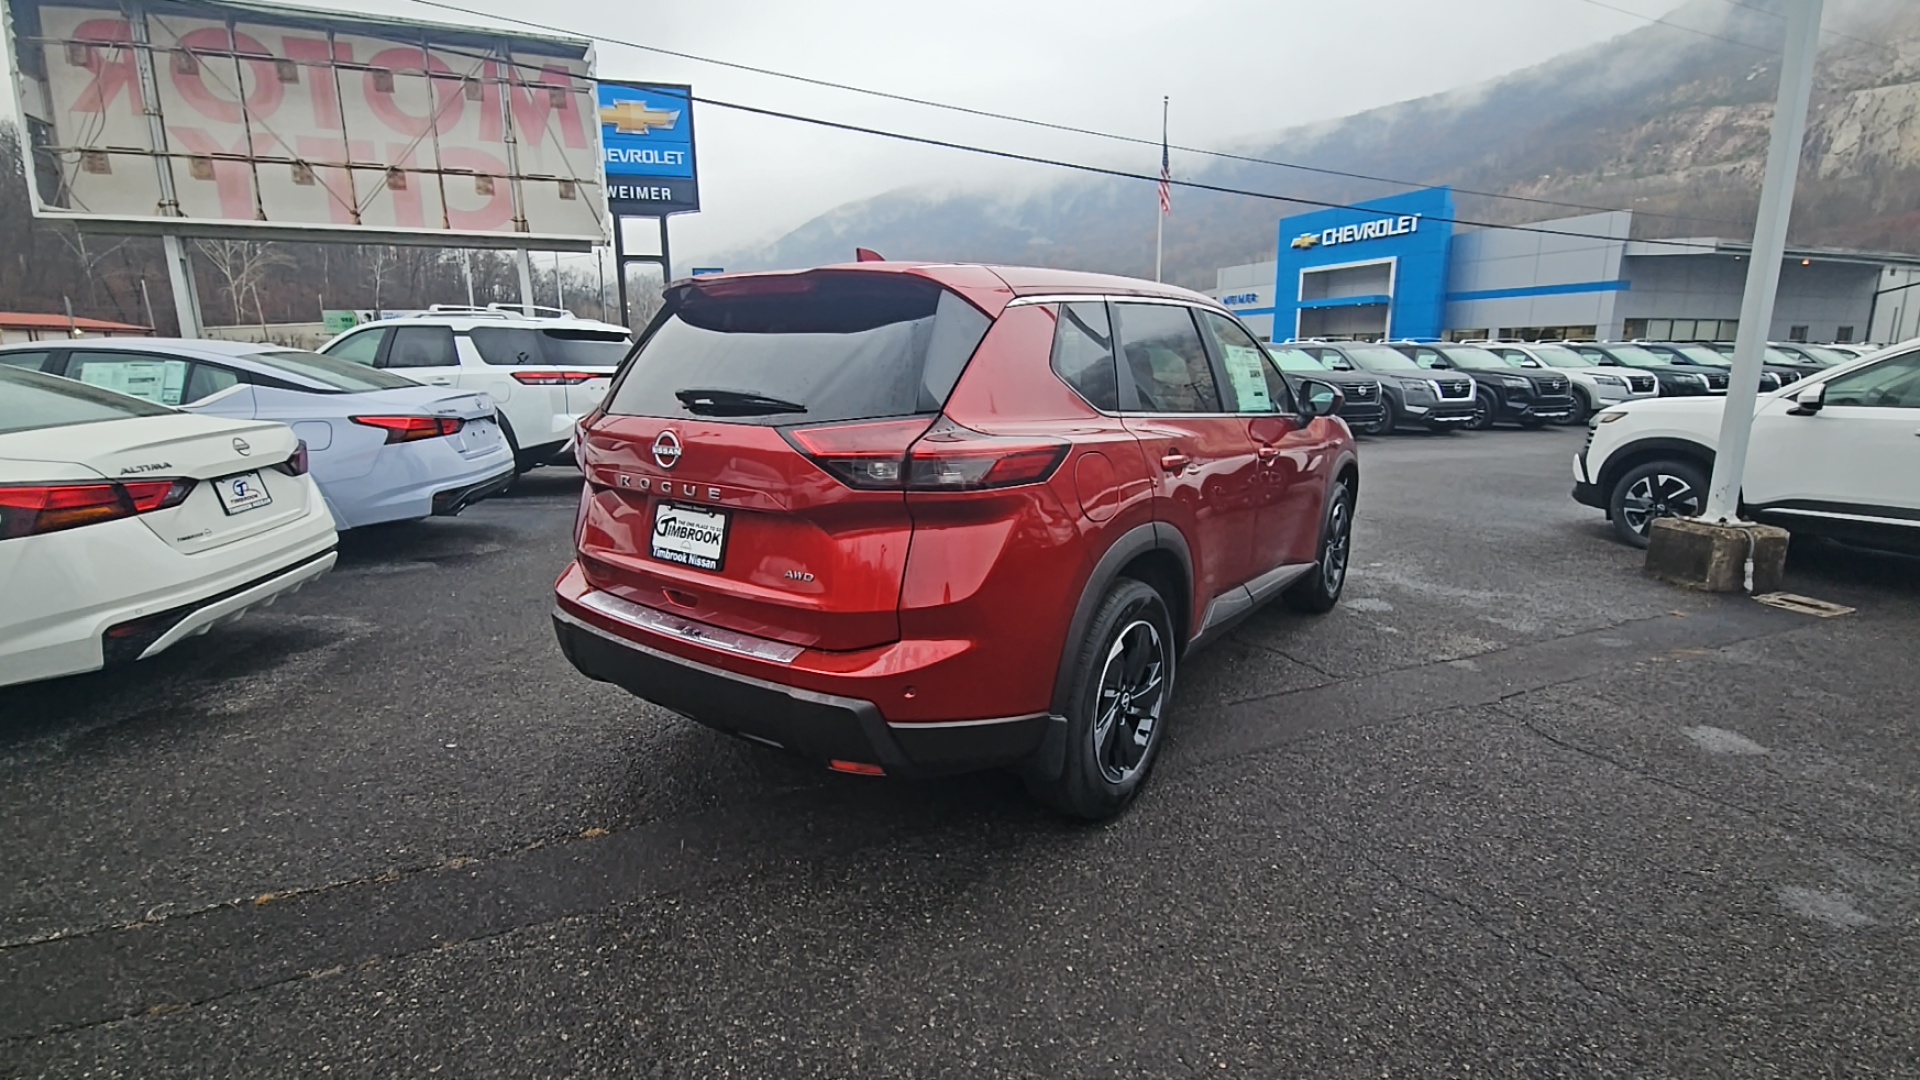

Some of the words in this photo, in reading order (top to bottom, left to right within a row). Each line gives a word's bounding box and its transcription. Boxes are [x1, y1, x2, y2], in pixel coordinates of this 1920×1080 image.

[602, 148, 685, 165] EVROLET
[607, 185, 672, 200] WEIMER
[1321, 213, 1422, 247] CHEVROLET
[120, 462, 173, 476] ALTIMA
[620, 474, 721, 500] ROGUE
[655, 514, 721, 546] TIMBROOK
[653, 547, 688, 563] Timbrook
[688, 554, 717, 569] Nissan
[784, 569, 815, 582] AWD
